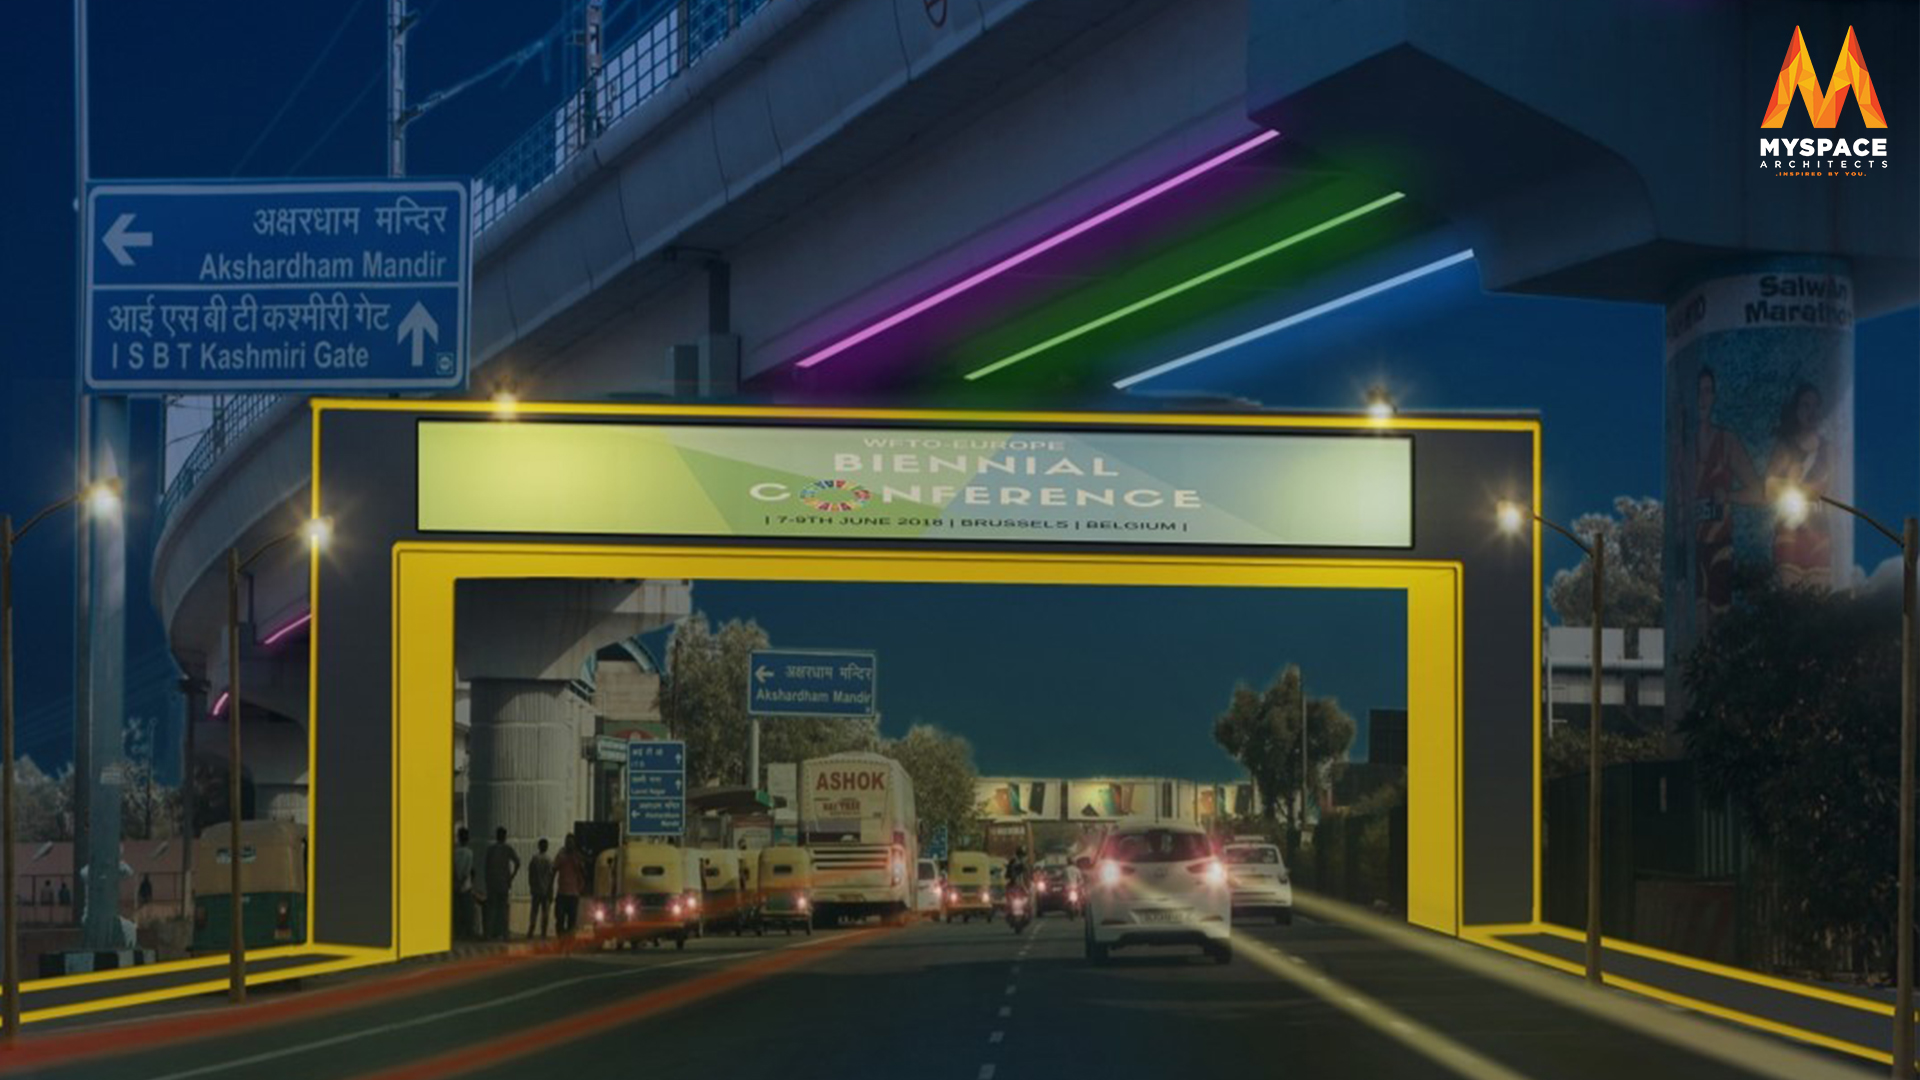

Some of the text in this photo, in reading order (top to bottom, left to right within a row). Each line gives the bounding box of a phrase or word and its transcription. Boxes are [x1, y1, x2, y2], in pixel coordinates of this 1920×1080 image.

[253, 195, 448, 236] अक्षरधाम मन्दिर
[200, 250, 447, 280] Akshardham Mandir
[107, 294, 155, 338] आई
[160, 305, 199, 338] एस
[263, 291, 349, 332] कश्मीरी
[354, 292, 390, 331] गेट
[201, 341, 305, 369] Kashmiri
[314, 341, 369, 369] Gate
[863, 438, 1065, 451] WFTO-EUROPE
[834, 453, 1120, 477] BIENNIAL
[838, 517, 891, 525] JUNE
[897, 518, 943, 526] 2018
[961, 519, 1069, 529] BRUSSELS
[1086, 521, 1176, 531] BELGIUM
[756, 688, 872, 704] Akshardham Mandir
[816, 772, 885, 791] ASHOK
